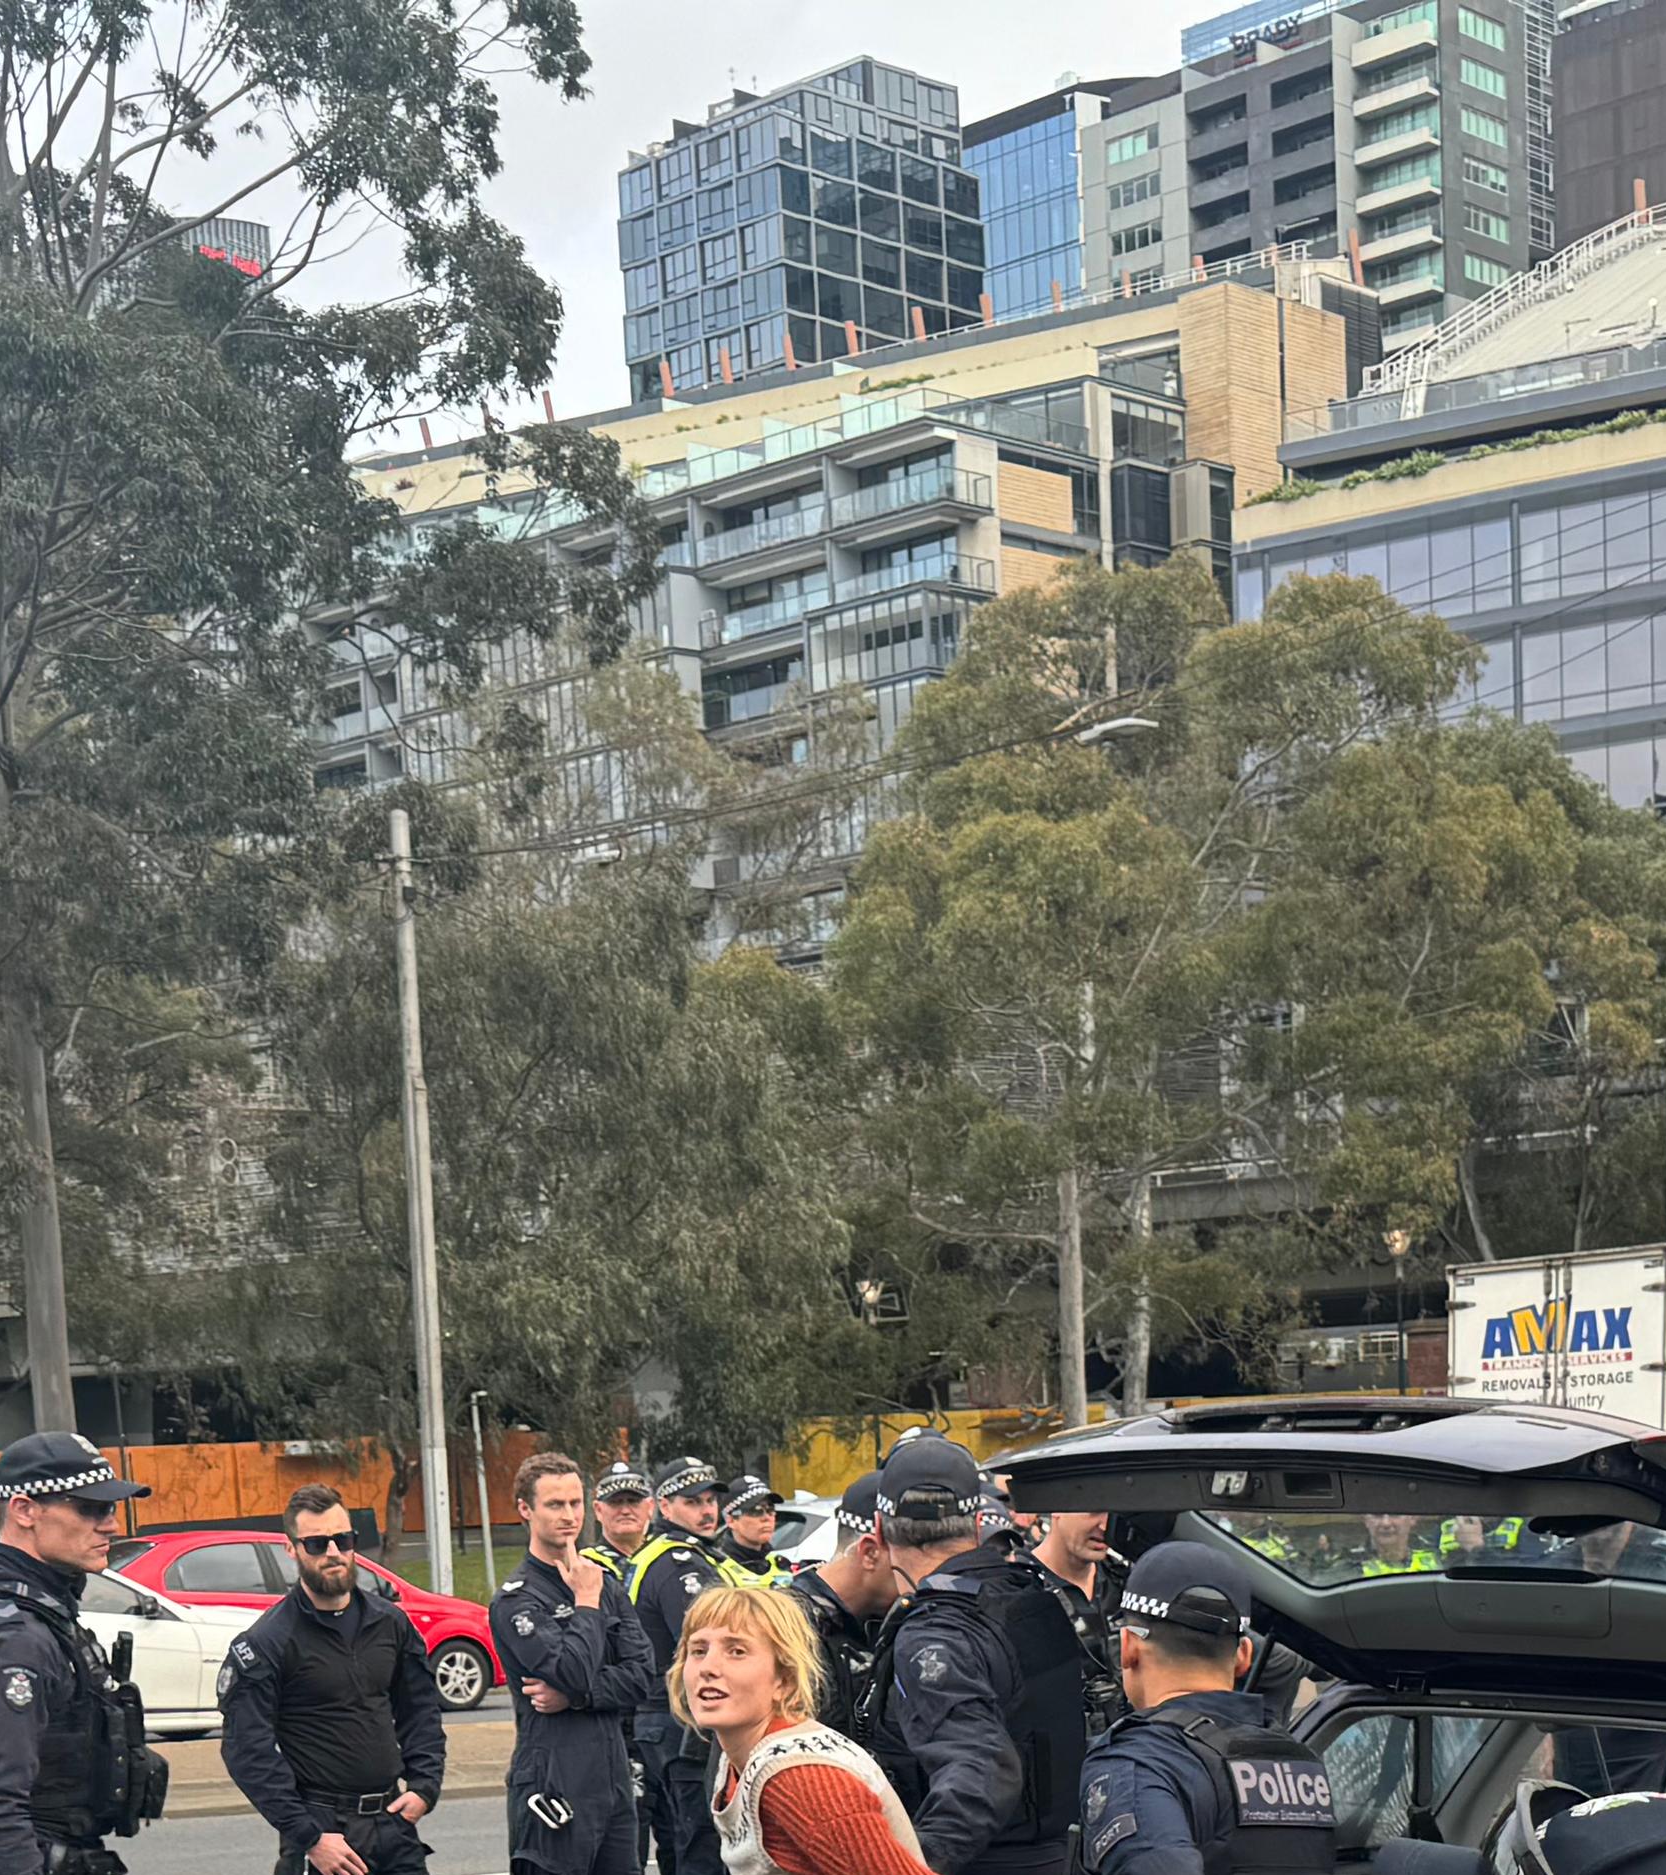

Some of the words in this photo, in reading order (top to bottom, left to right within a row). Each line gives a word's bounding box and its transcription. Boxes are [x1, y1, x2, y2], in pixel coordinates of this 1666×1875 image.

[1481, 1294, 1632, 1359] AMAX
[1482, 1377, 1551, 1392] REMOVALS
[1570, 1371, 1633, 1387] STORAGE
[235, 1641, 255, 1661] AFP
[1230, 1761, 1331, 1807] Police
[1095, 1822, 1121, 1853] PORT
